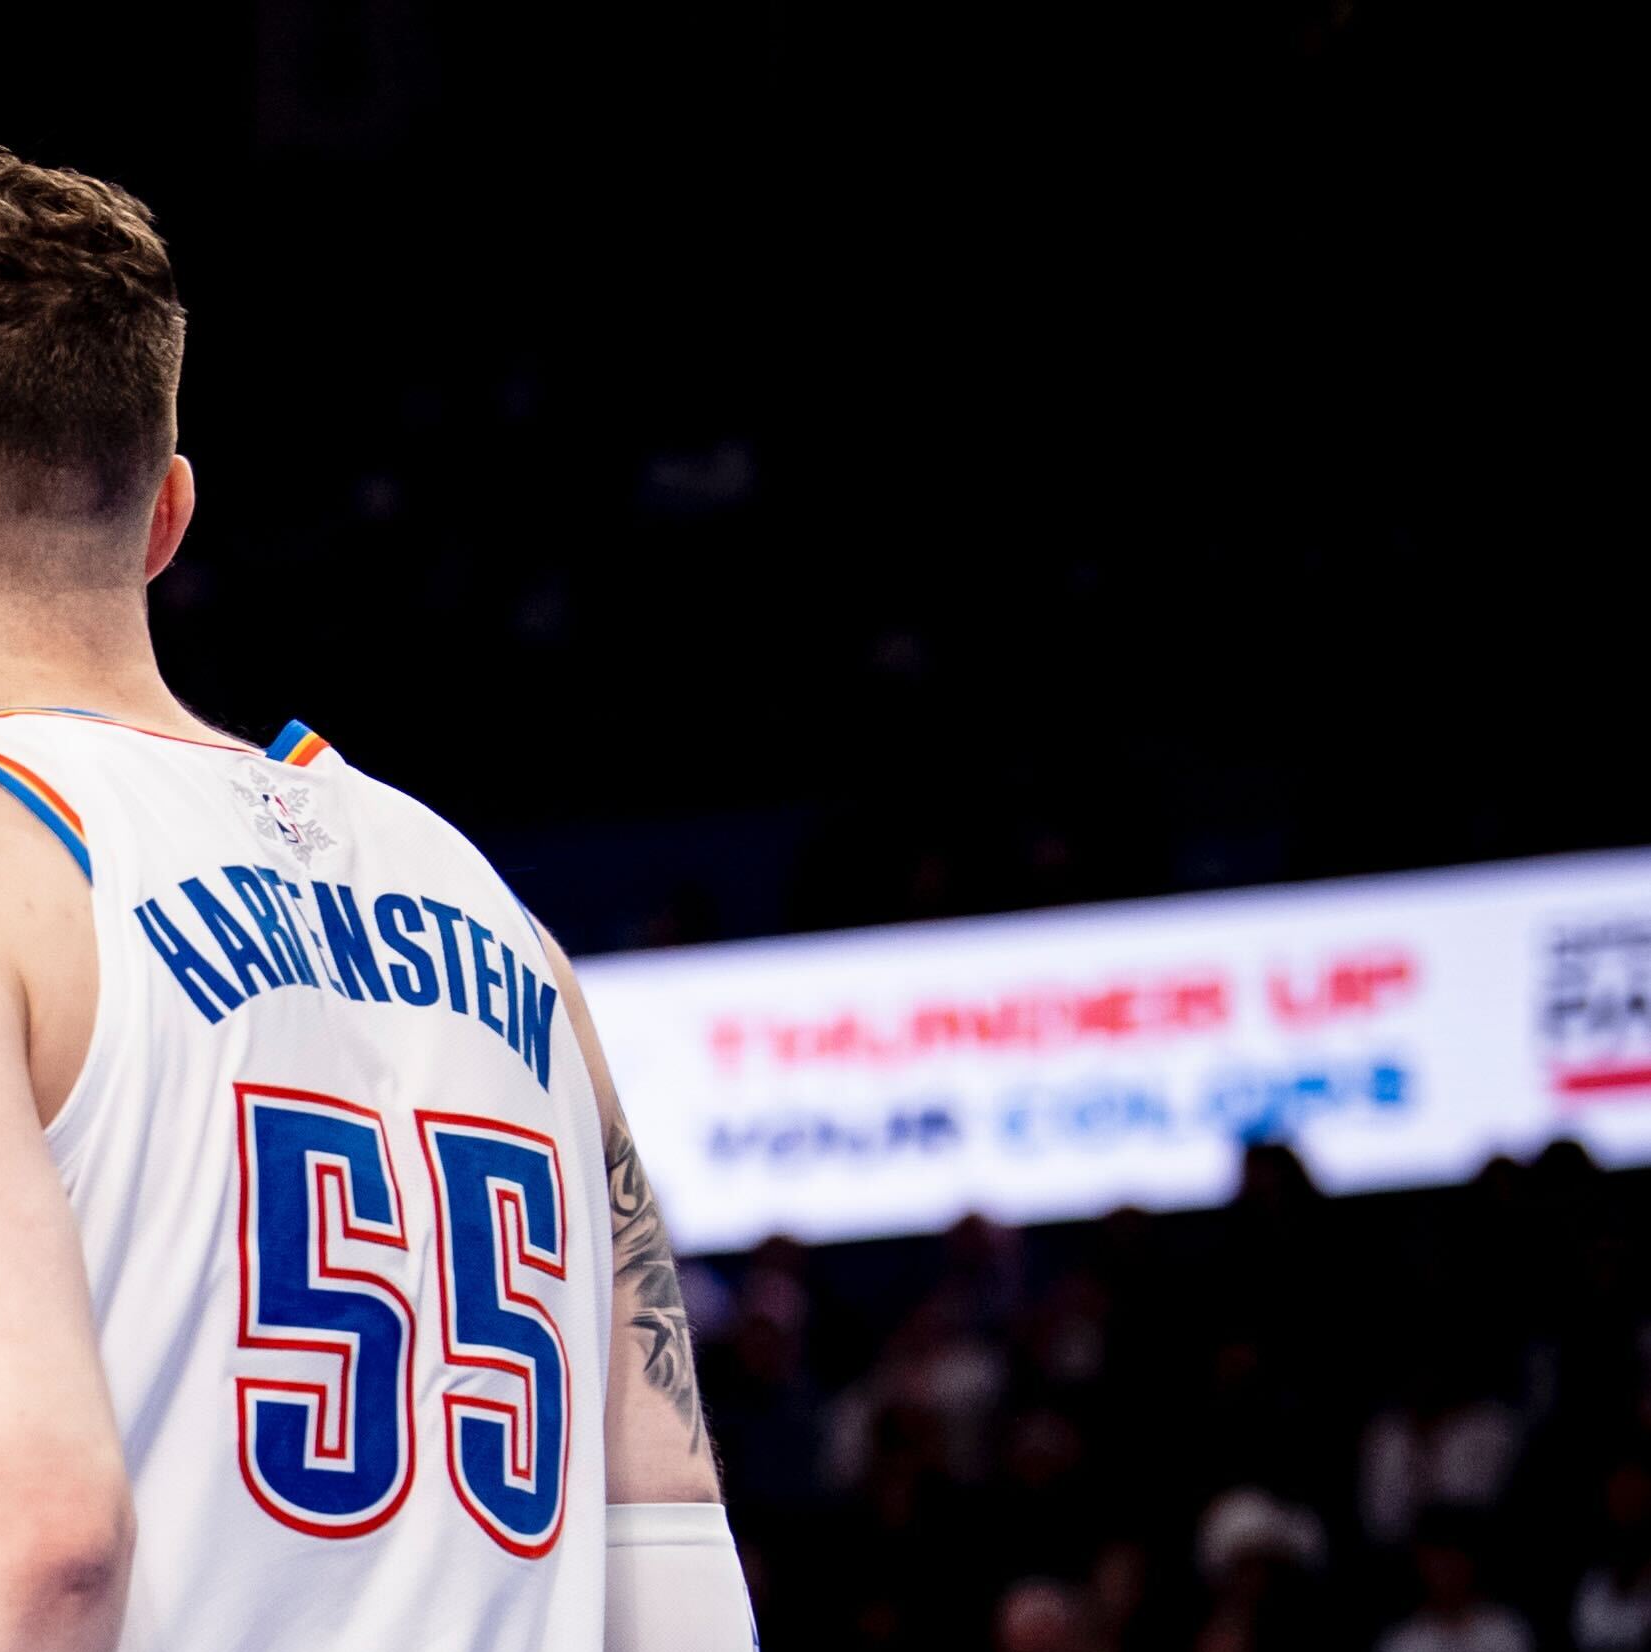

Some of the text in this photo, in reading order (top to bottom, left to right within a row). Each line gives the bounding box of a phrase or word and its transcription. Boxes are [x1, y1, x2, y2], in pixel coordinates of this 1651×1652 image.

[134, 864, 558, 1091] HARTNSTEIN
[707, 948, 1419, 1075] THUNDER UP
[233, 1083, 570, 1559] 55
